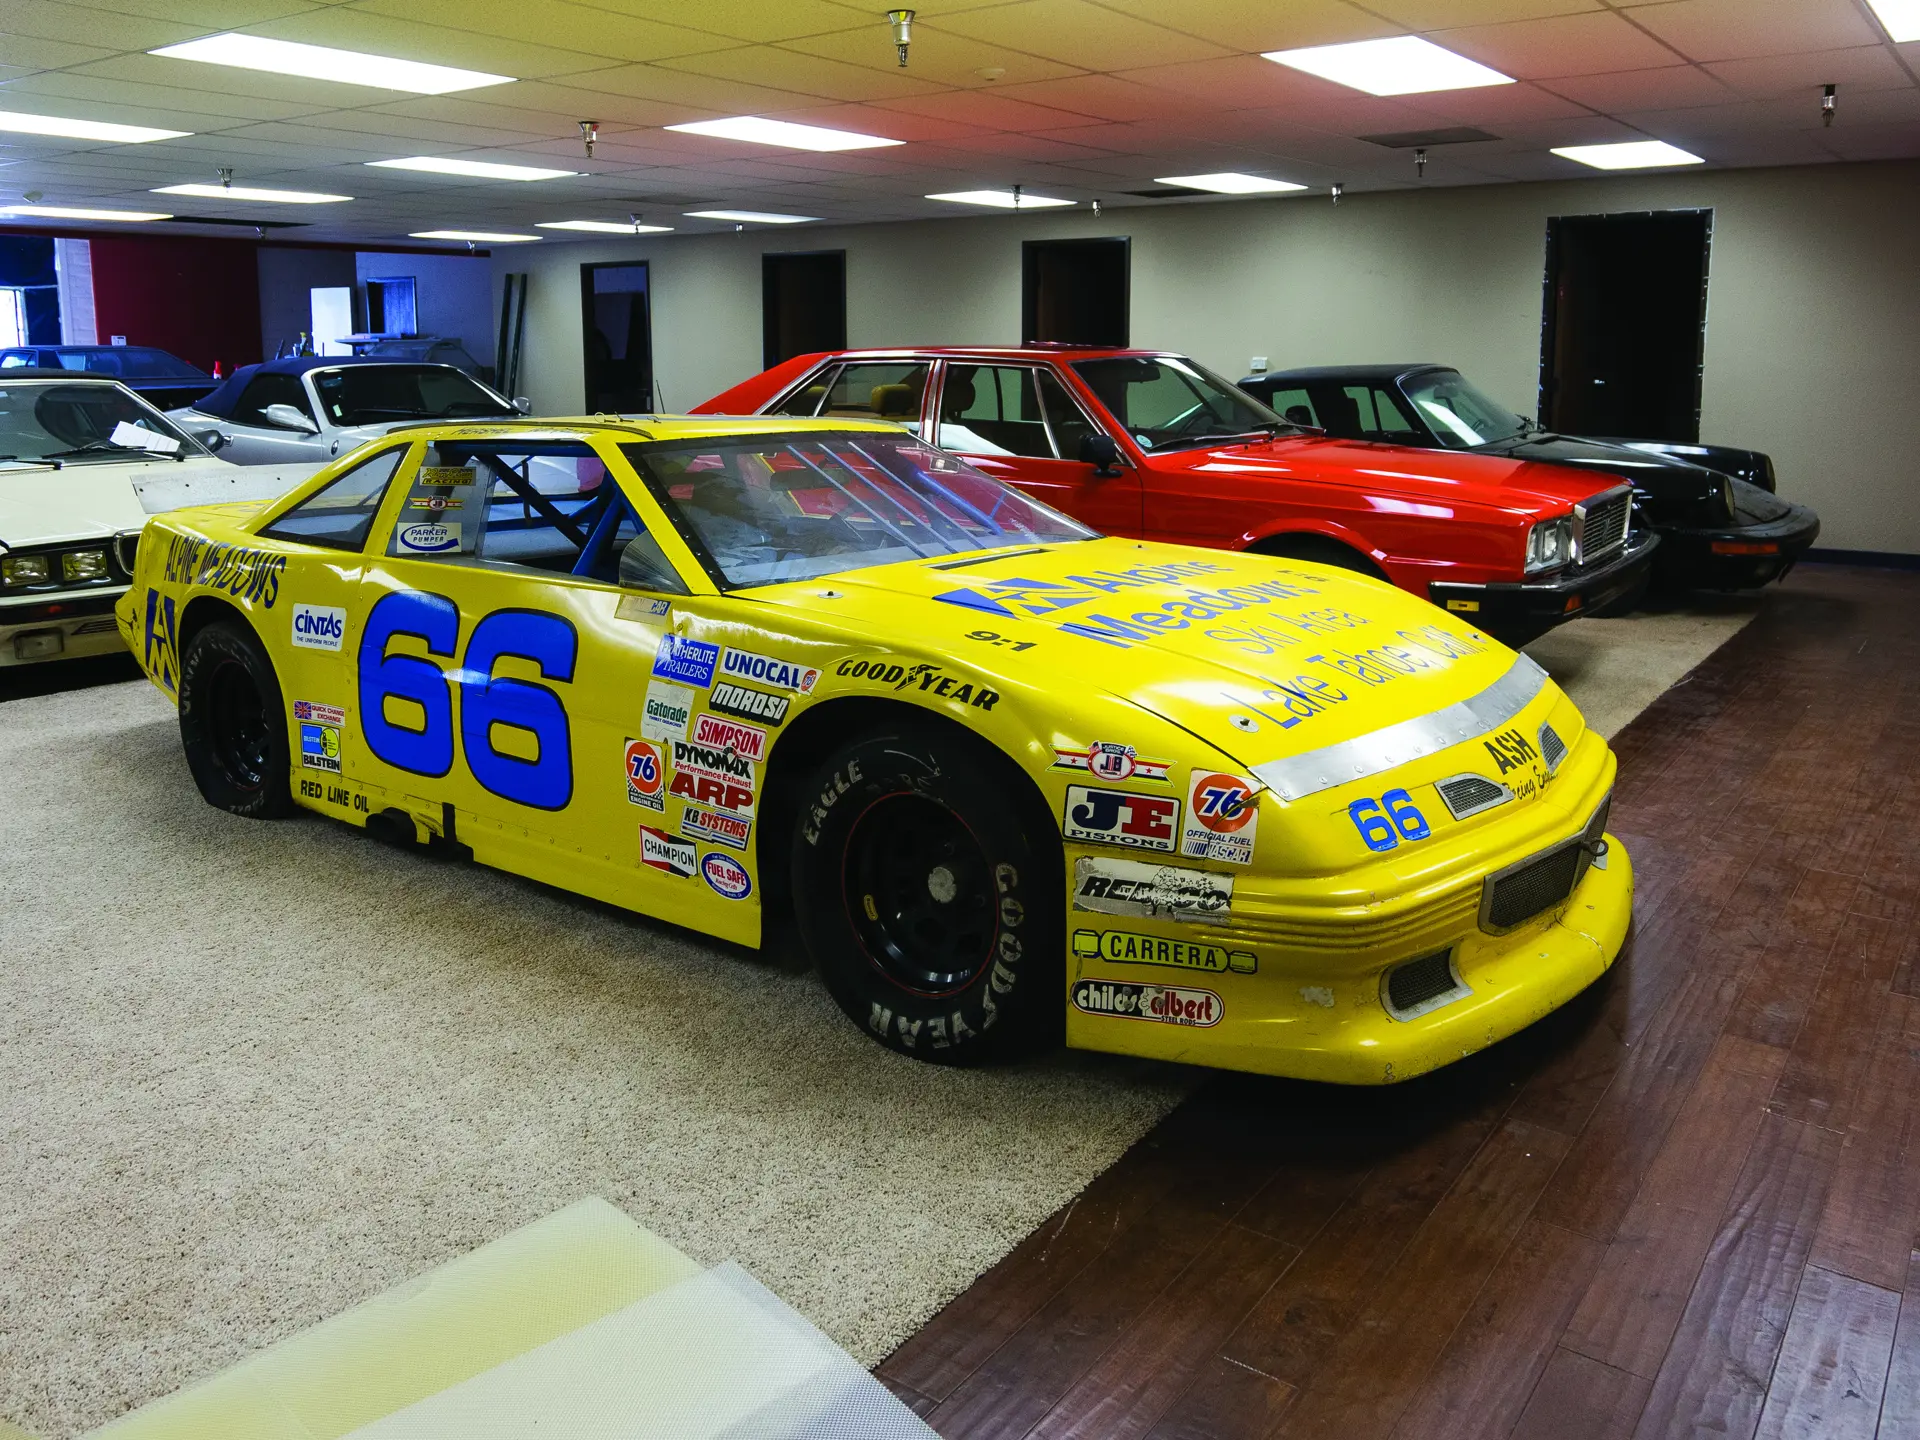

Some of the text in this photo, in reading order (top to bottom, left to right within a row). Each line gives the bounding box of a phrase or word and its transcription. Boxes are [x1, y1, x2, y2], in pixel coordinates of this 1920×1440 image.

[411, 527, 448, 536] PARKER
[164, 534, 287, 609] ALPINE MEADOWS
[1064, 561, 1236, 593] Alpine
[1056, 580, 1320, 649] Meadows
[964, 630, 1038, 652] 9:1
[1204, 608, 1373, 655] Ski Area
[661, 641, 716, 665] FEATHERLITE
[661, 658, 709, 680] TRAILERS
[724, 651, 800, 688] UNOCAL
[312, 704, 345, 717] QUICK CHANGE
[357, 590, 579, 812] 66
[647, 698, 688, 724] Gatorade
[1220, 675, 1348, 730] Lake
[317, 713, 342, 723] EXCHANGE
[303, 735, 321, 743] BILSTEIN
[698, 719, 762, 757] SIMPSON
[1483, 729, 1538, 775] ASH
[303, 755, 340, 771] BILSTEIN
[630, 754, 656, 783] 76
[675, 741, 752, 780] DYNOMAX
[675, 760, 752, 789] Performance Exhaust
[301, 780, 369, 813] RED LINE OIL
[630, 795, 663, 811] ENGINE OIL
[669, 771, 754, 811] ARP
[802, 757, 864, 846] EAGLE
[1198, 785, 1248, 820] 76
[684, 808, 747, 839] KB SYSTEMS
[1072, 791, 1175, 840] JE
[1347, 788, 1431, 852] 66
[644, 838, 695, 867] CHAMPION
[1070, 828, 1170, 850] PISTONS
[1186, 829, 1252, 846] OFFICIAL FUEL
[1206, 844, 1250, 863] NASCAR
[707, 860, 726, 879] FUEL
[726, 868, 746, 886] SAFE
[1110, 935, 1218, 968] CARRERA
[1160, 1015, 1197, 1026] STEEL RODS
